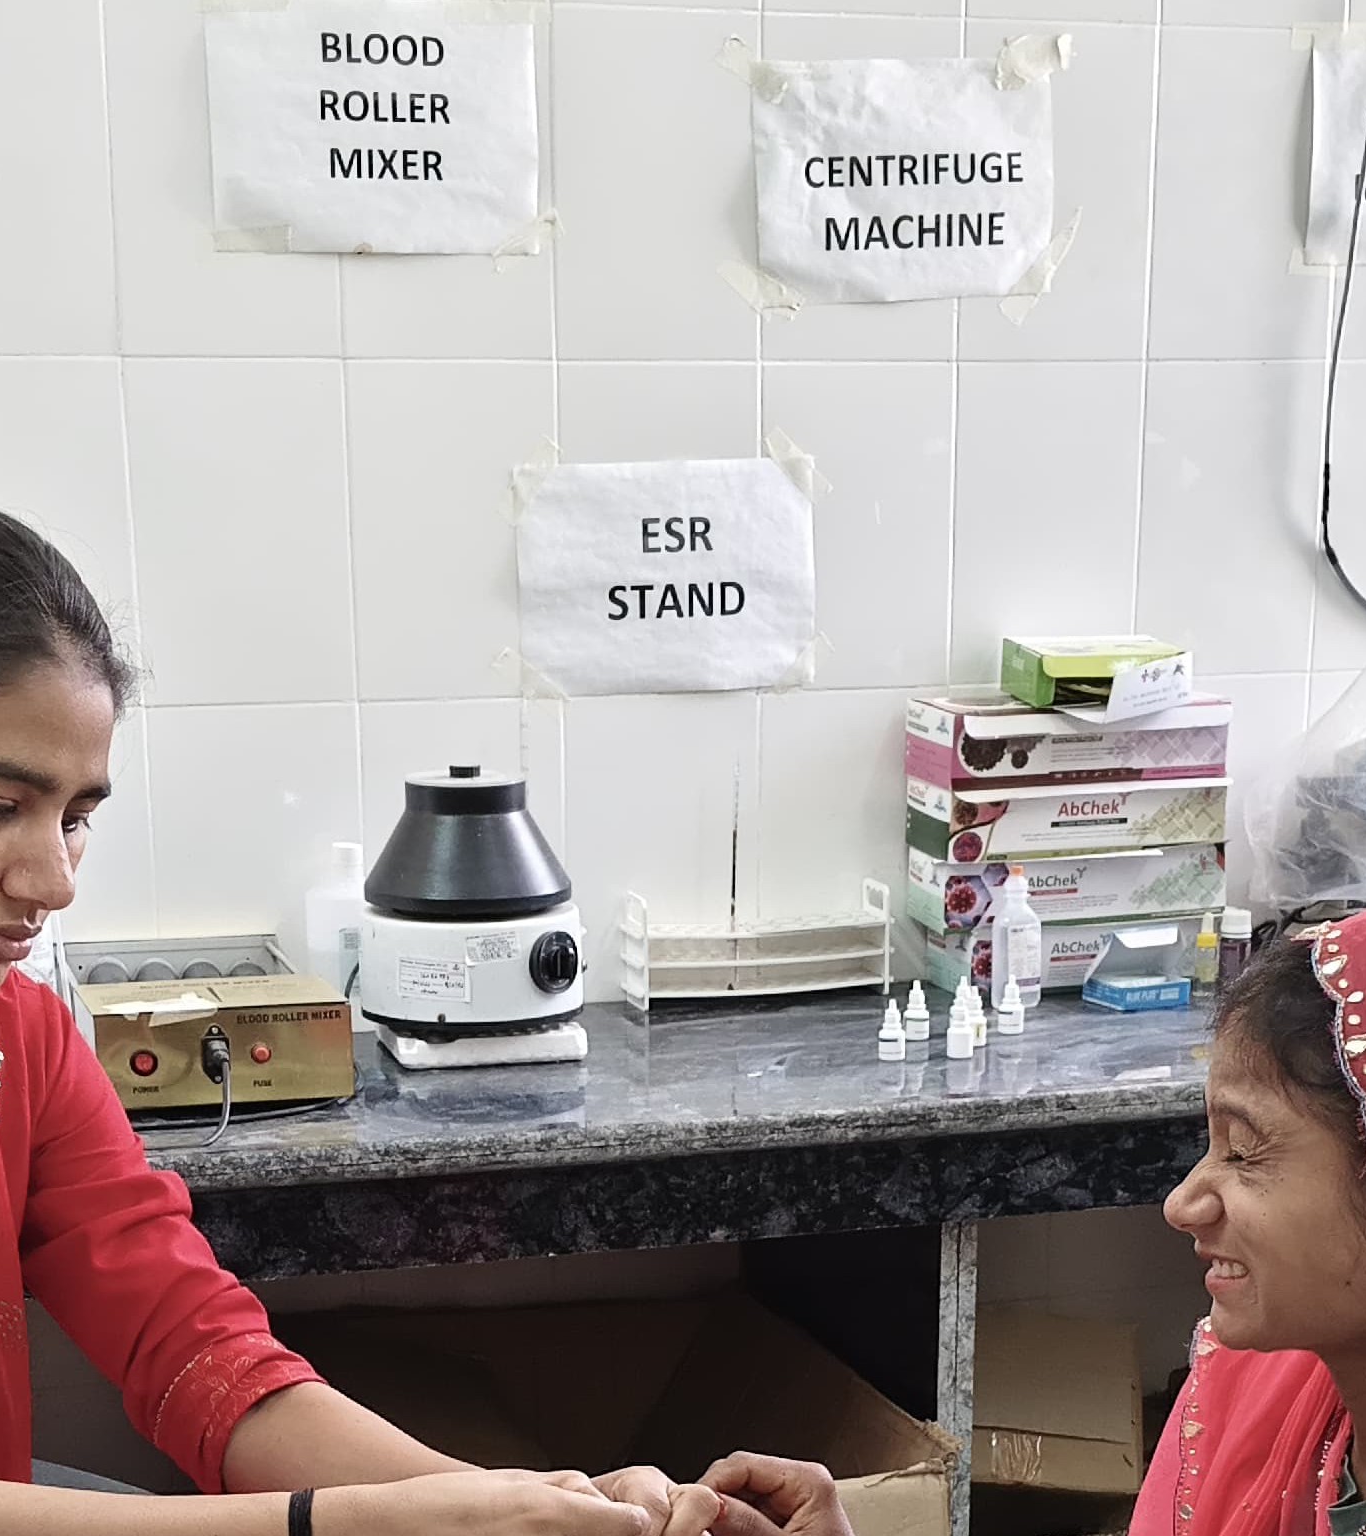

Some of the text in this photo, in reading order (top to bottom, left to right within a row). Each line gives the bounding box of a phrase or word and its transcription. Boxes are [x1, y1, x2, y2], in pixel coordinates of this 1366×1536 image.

[321, 32, 444, 67] BLOOD
[320, 89, 450, 125] ROLLER
[329, 147, 443, 181] MIXER
[804, 152, 1023, 189] CENTRIFUGE
[825, 212, 1005, 251] MACHINE
[642, 516, 713, 553] ESR
[608, 581, 745, 621] STAND
[1057, 799, 1120, 817] AbChek
[1028, 874, 1078, 888] AbChek
[1051, 940, 1100, 954] AbChek
